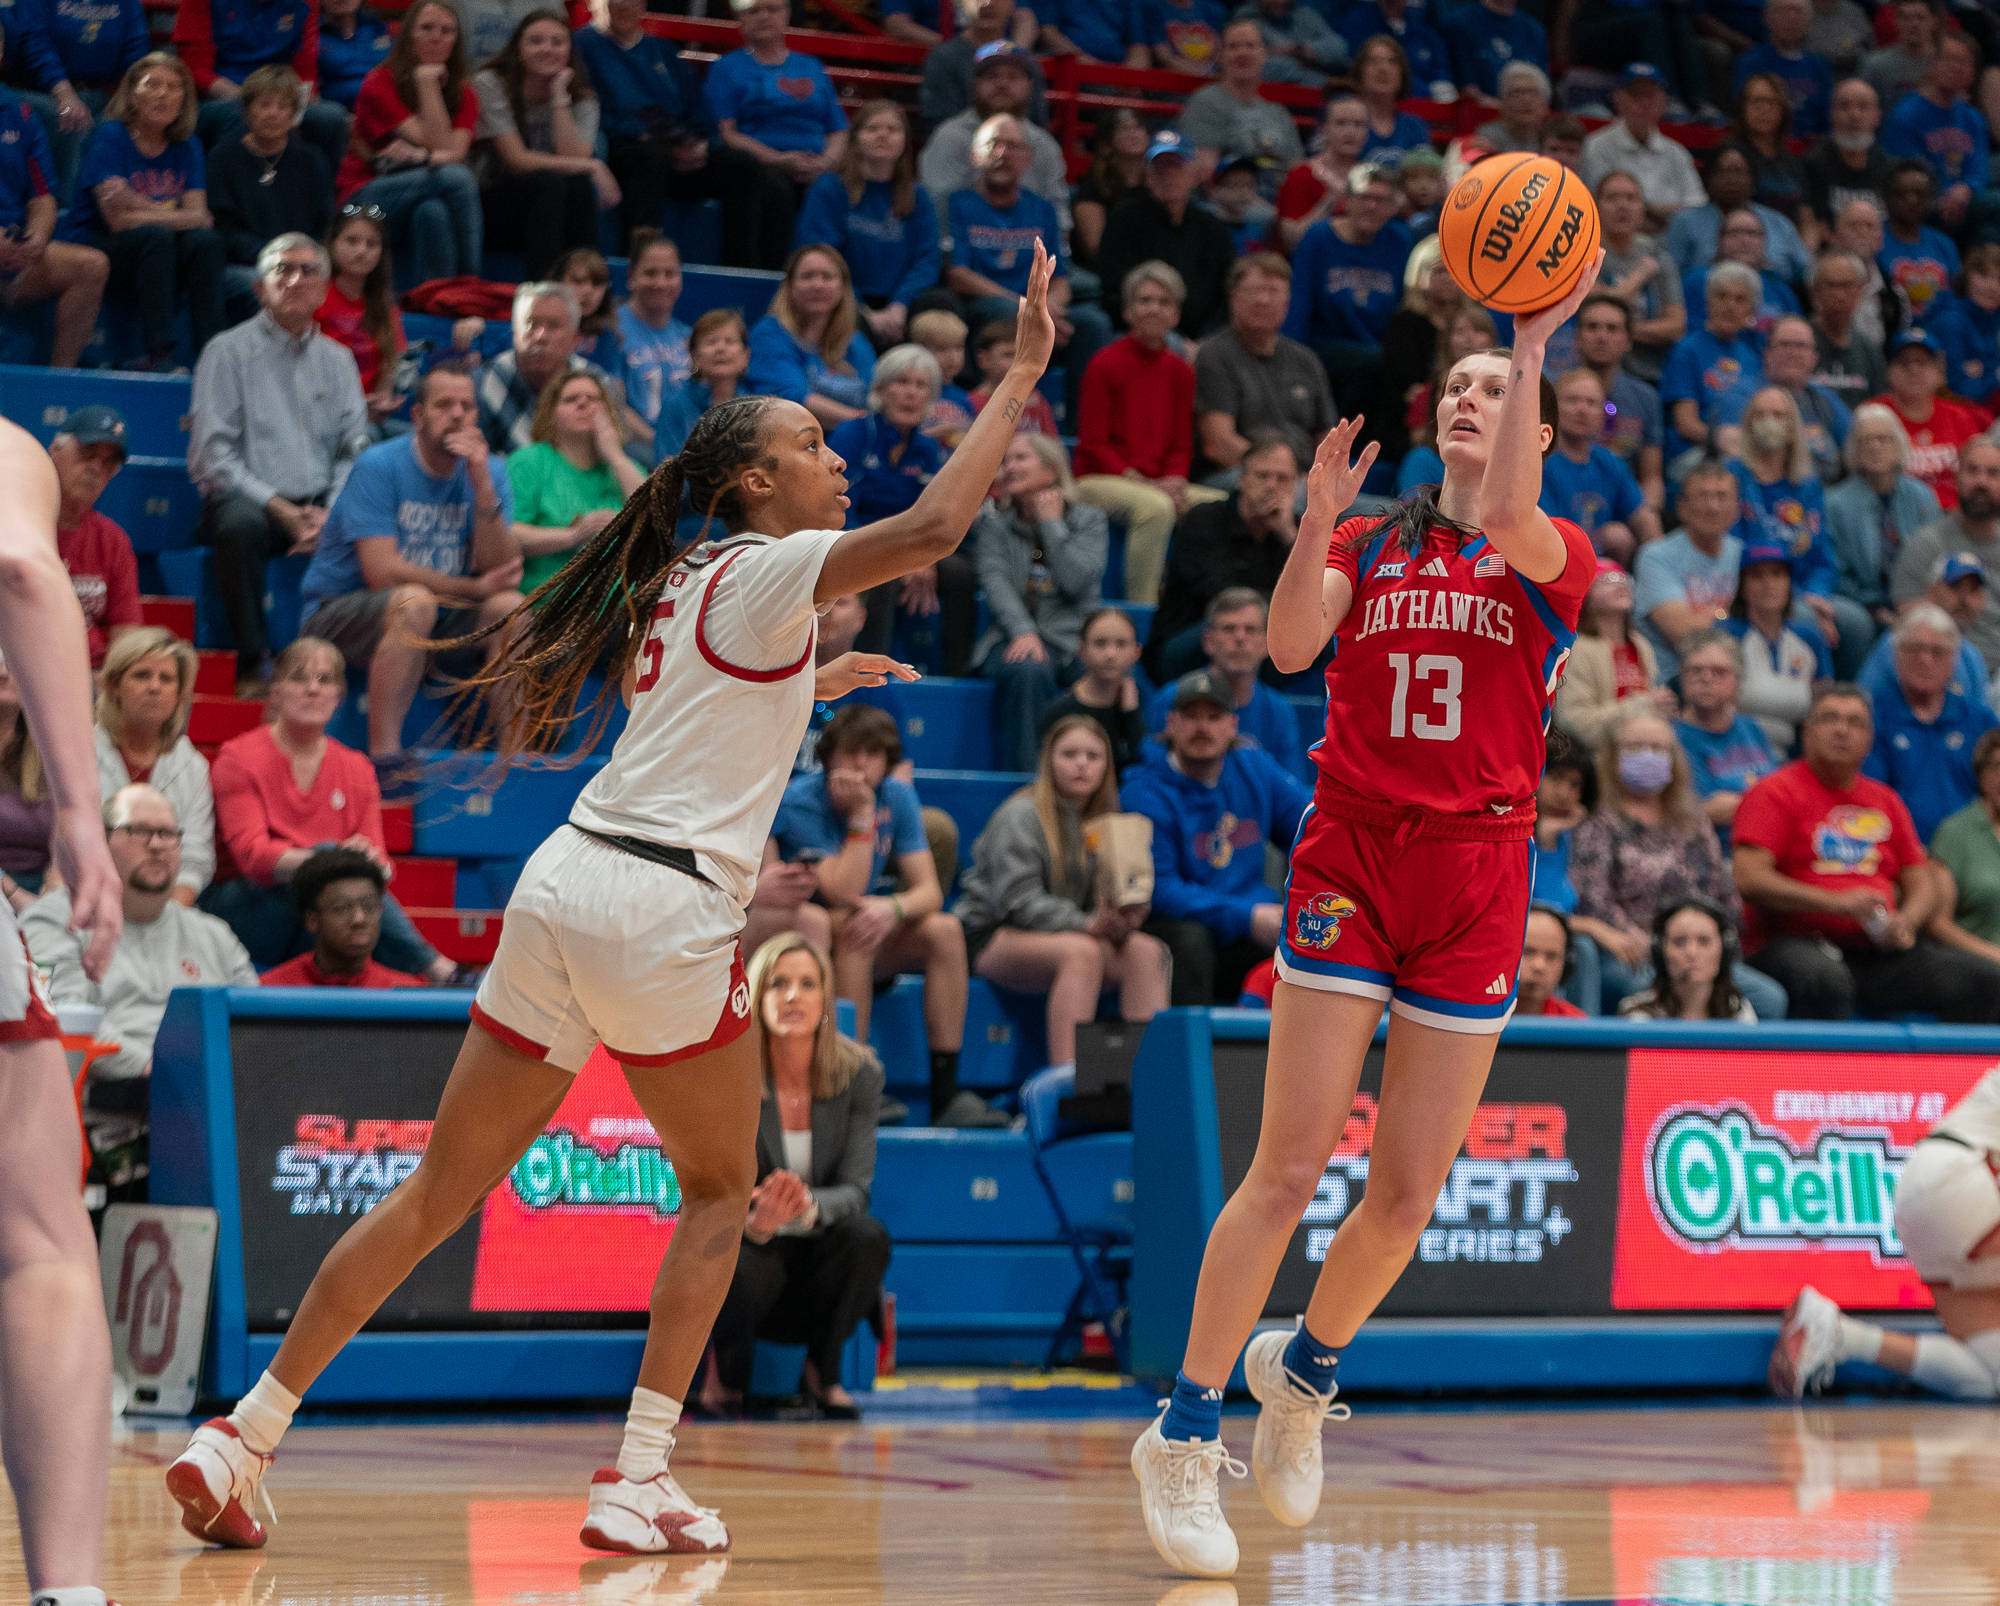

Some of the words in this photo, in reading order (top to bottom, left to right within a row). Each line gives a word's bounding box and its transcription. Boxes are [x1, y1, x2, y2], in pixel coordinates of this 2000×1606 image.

[1481, 172, 1551, 263] Wilson
[1536, 202, 1585, 279] NCAA
[1002, 397, 1023, 424] 222
[1355, 589, 1514, 646] JAYHAWKS
[1388, 652, 1463, 742] 13
[1308, 919, 1321, 931] KU
[1772, 1089, 1914, 1122] EXCLUSIVELY
[271, 1146, 424, 1191] STAR
